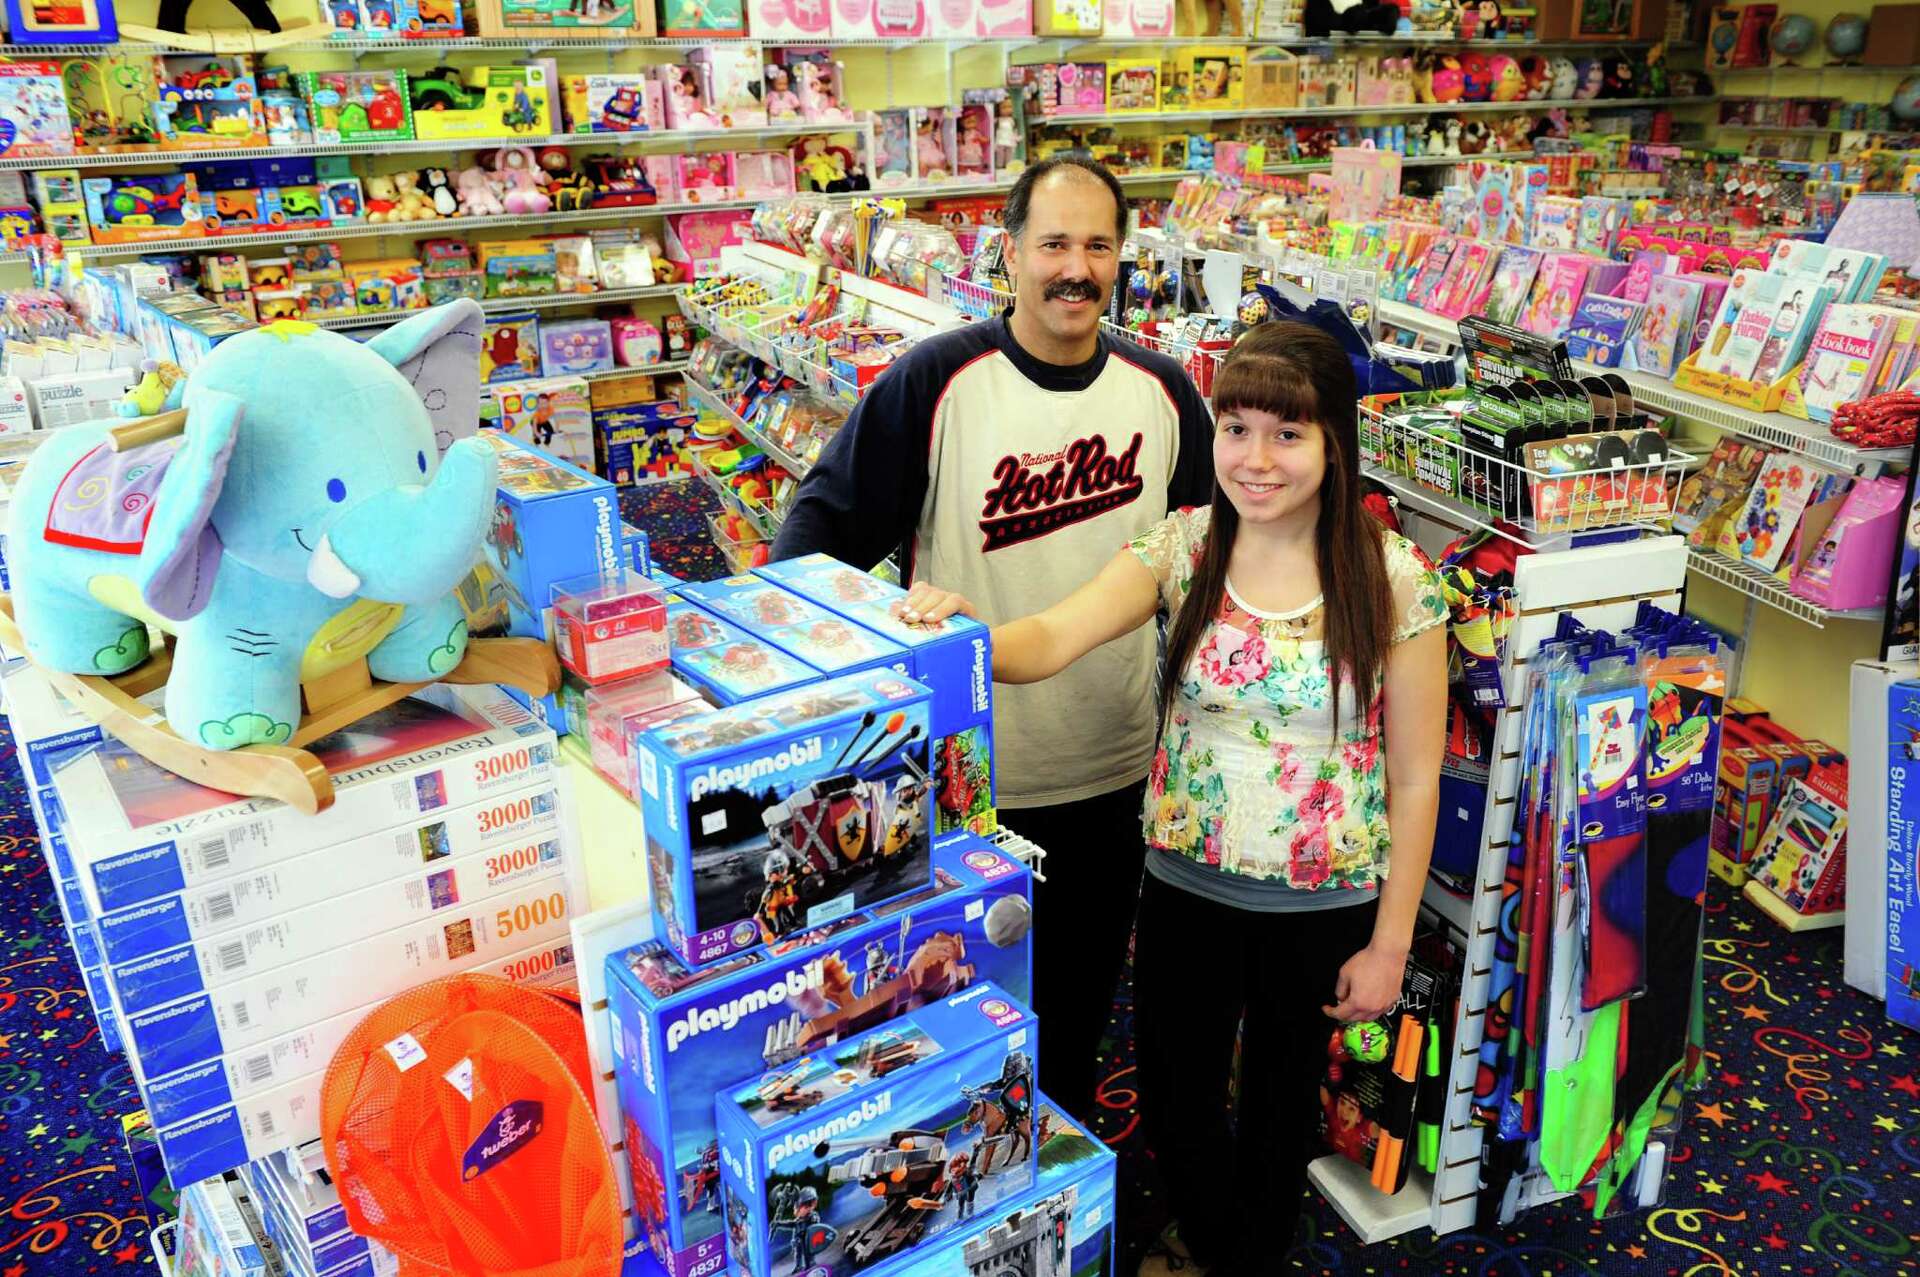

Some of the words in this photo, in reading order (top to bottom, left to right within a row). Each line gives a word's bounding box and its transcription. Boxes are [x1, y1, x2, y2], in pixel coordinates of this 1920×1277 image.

[39, 385, 84, 402] puzzle
[1020, 444, 1068, 467] National
[982, 455, 1065, 518] Hot
[1062, 432, 1143, 500] Rod
[593, 496, 620, 579] playmobil
[971, 638, 989, 712] playmobil
[30, 729, 97, 752] Ravensburger
[328, 735, 496, 787] Ravensburg
[474, 748, 530, 783] 3000
[691, 736, 823, 803] playmobil
[477, 798, 531, 833] 3000
[1887, 766, 1906, 853] Standing
[95, 846, 171, 873] Ravensburger
[485, 845, 539, 880] 3000
[1889, 857, 1905, 892] Art
[102, 900, 178, 928] Ravensburger
[495, 892, 566, 940] 5000
[1888, 897, 1905, 953] Easel
[699, 929, 726, 946] 4-10
[699, 943, 729, 961] 4867
[116, 949, 190, 978] Ravensburger
[502, 951, 555, 982] 3000
[134, 999, 208, 1029] Ravensburger
[666, 959, 825, 1053] playmobil
[148, 1064, 220, 1094] Ravensburger
[164, 1111, 233, 1142] Ravensburger
[481, 1119, 532, 1158] tweber
[768, 1091, 892, 1170] playmobil
[688, 1256, 722, 1277] 4837
